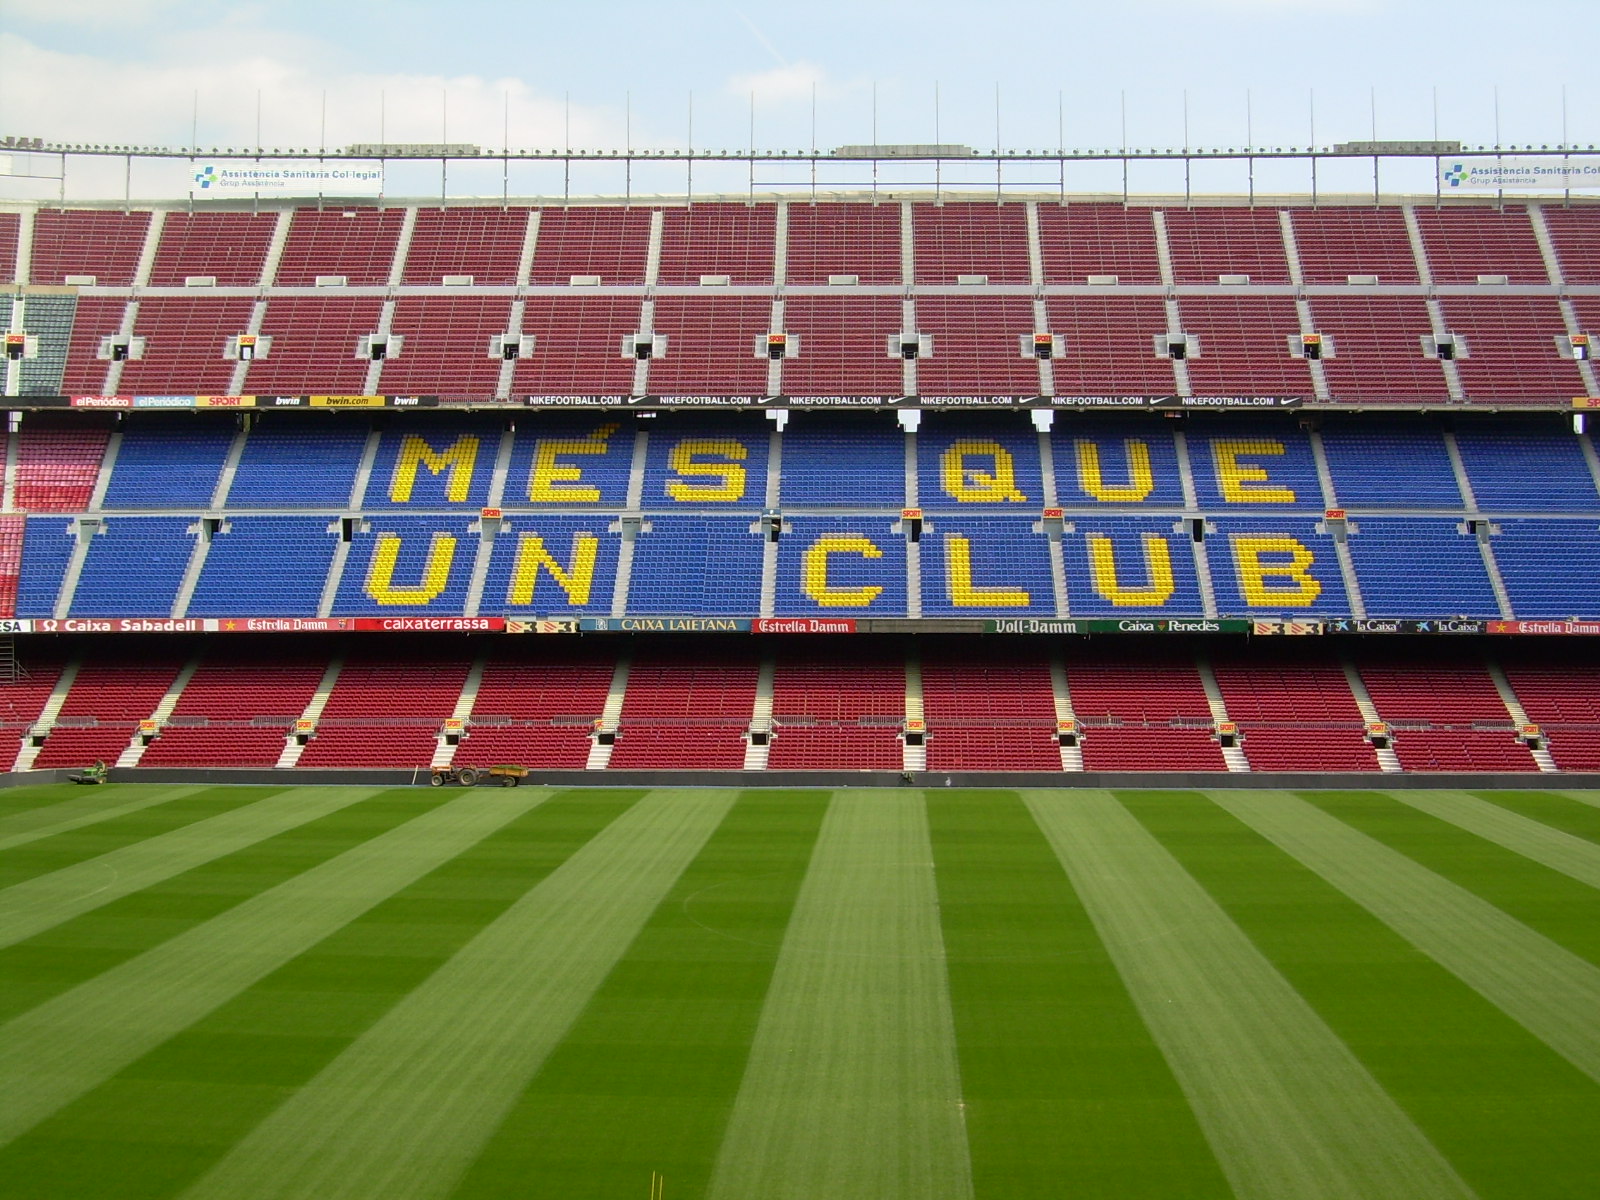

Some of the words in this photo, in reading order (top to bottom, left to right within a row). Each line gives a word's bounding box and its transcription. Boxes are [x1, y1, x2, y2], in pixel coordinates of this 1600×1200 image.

[221, 169, 280, 178] Assistència
[282, 169, 330, 178] Sanitària
[1470, 166, 1531, 175] Assistència
[1533, 166, 1581, 175] Sanitària
[219, 180, 240, 188] Grup
[1470, 177, 1491, 185] Grup
[209, 397, 242, 405] SPORT
[275, 397, 300, 405] bwin
[326, 397, 369, 405] bwin.com
[394, 397, 418, 405] bwin
[529, 396, 621, 405] NIKEFOOTBALL.COM
[660, 396, 751, 404] NIKEFOOTBALL.COM
[789, 396, 881, 405] NIKEFOOTBALL.COM
[920, 396, 1012, 405] NIKEFOOTBALL.COM
[1051, 396, 1143, 405] NIKEFOOTBALL.COM
[1182, 397, 1274, 406] NIKEFOOTBALL.COM
[388, 423, 750, 502] MÉS
[939, 438, 1296, 503] QUE
[483, 509, 500, 517] SPORT
[1044, 509, 1062, 517] SPORT
[1326, 510, 1344, 518] SPORT
[362, 532, 599, 606] UN
[801, 533, 1321, 607] CLUB
[65, 620, 111, 632] Caixa
[121, 619, 196, 632] Sabadell
[247, 619, 290, 631] Estrella
[293, 619, 328, 630] Damm
[383, 618, 489, 630] caixaterrassa
[621, 619, 665, 630] CAIXA
[669, 619, 737, 630] LAIETANA
[759, 620, 807, 633] Estrella
[809, 620, 849, 632] Damm
[995, 620, 1077, 633] Voll-Damm
[1119, 620, 1154, 631] Caixa
[1168, 620, 1220, 632] Penedès
[1519, 620, 1561, 633] Estrella
[1565, 620, 1600, 633] Damm
